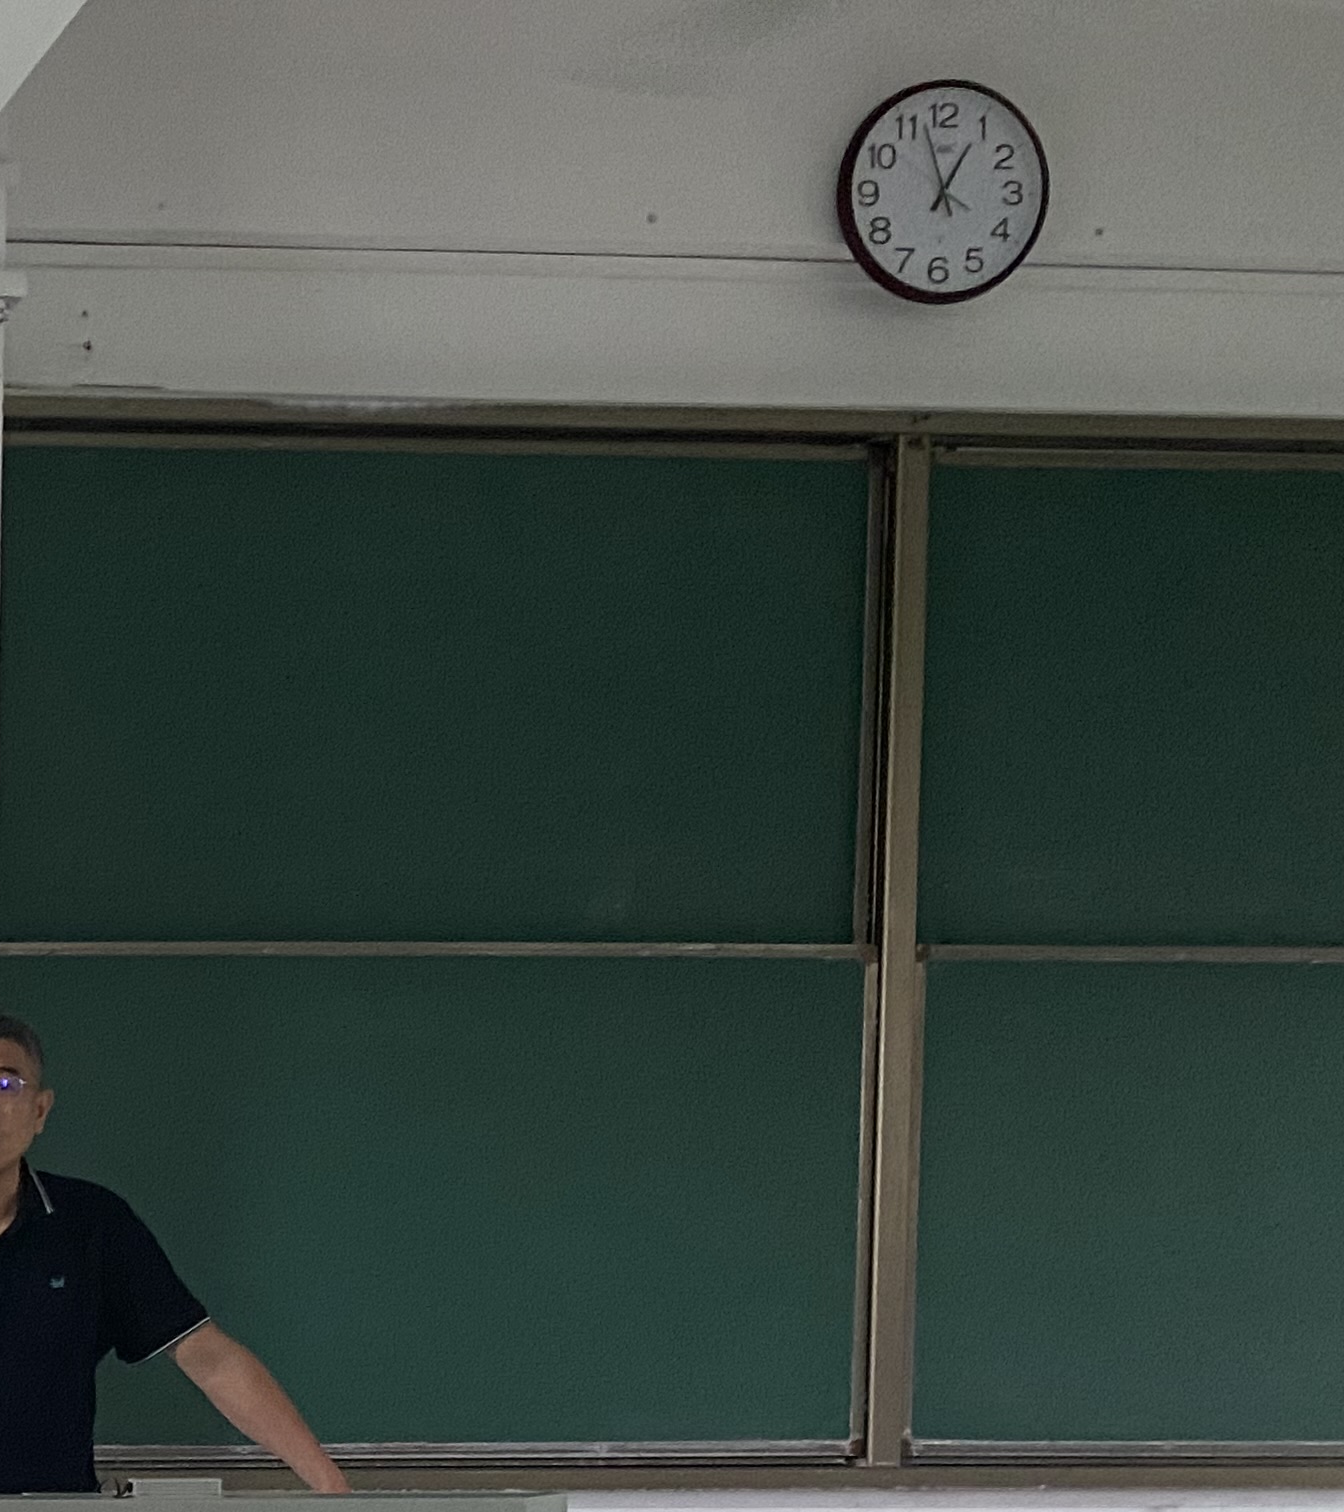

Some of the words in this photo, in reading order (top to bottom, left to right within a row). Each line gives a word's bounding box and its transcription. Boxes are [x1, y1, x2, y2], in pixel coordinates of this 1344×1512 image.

[895, 114, 918, 140] 11
[929, 102, 959, 128] 12
[978, 115, 987, 141] 1
[868, 143, 897, 170] 10
[994, 143, 1015, 170] 2
[857, 180, 880, 207] 9
[1000, 181, 1023, 206] 3
[868, 216, 891, 245] 8
[990, 217, 1010, 242] 4
[895, 247, 915, 274] 7
[927, 256, 949, 284] 6
[965, 247, 984, 274] 5
